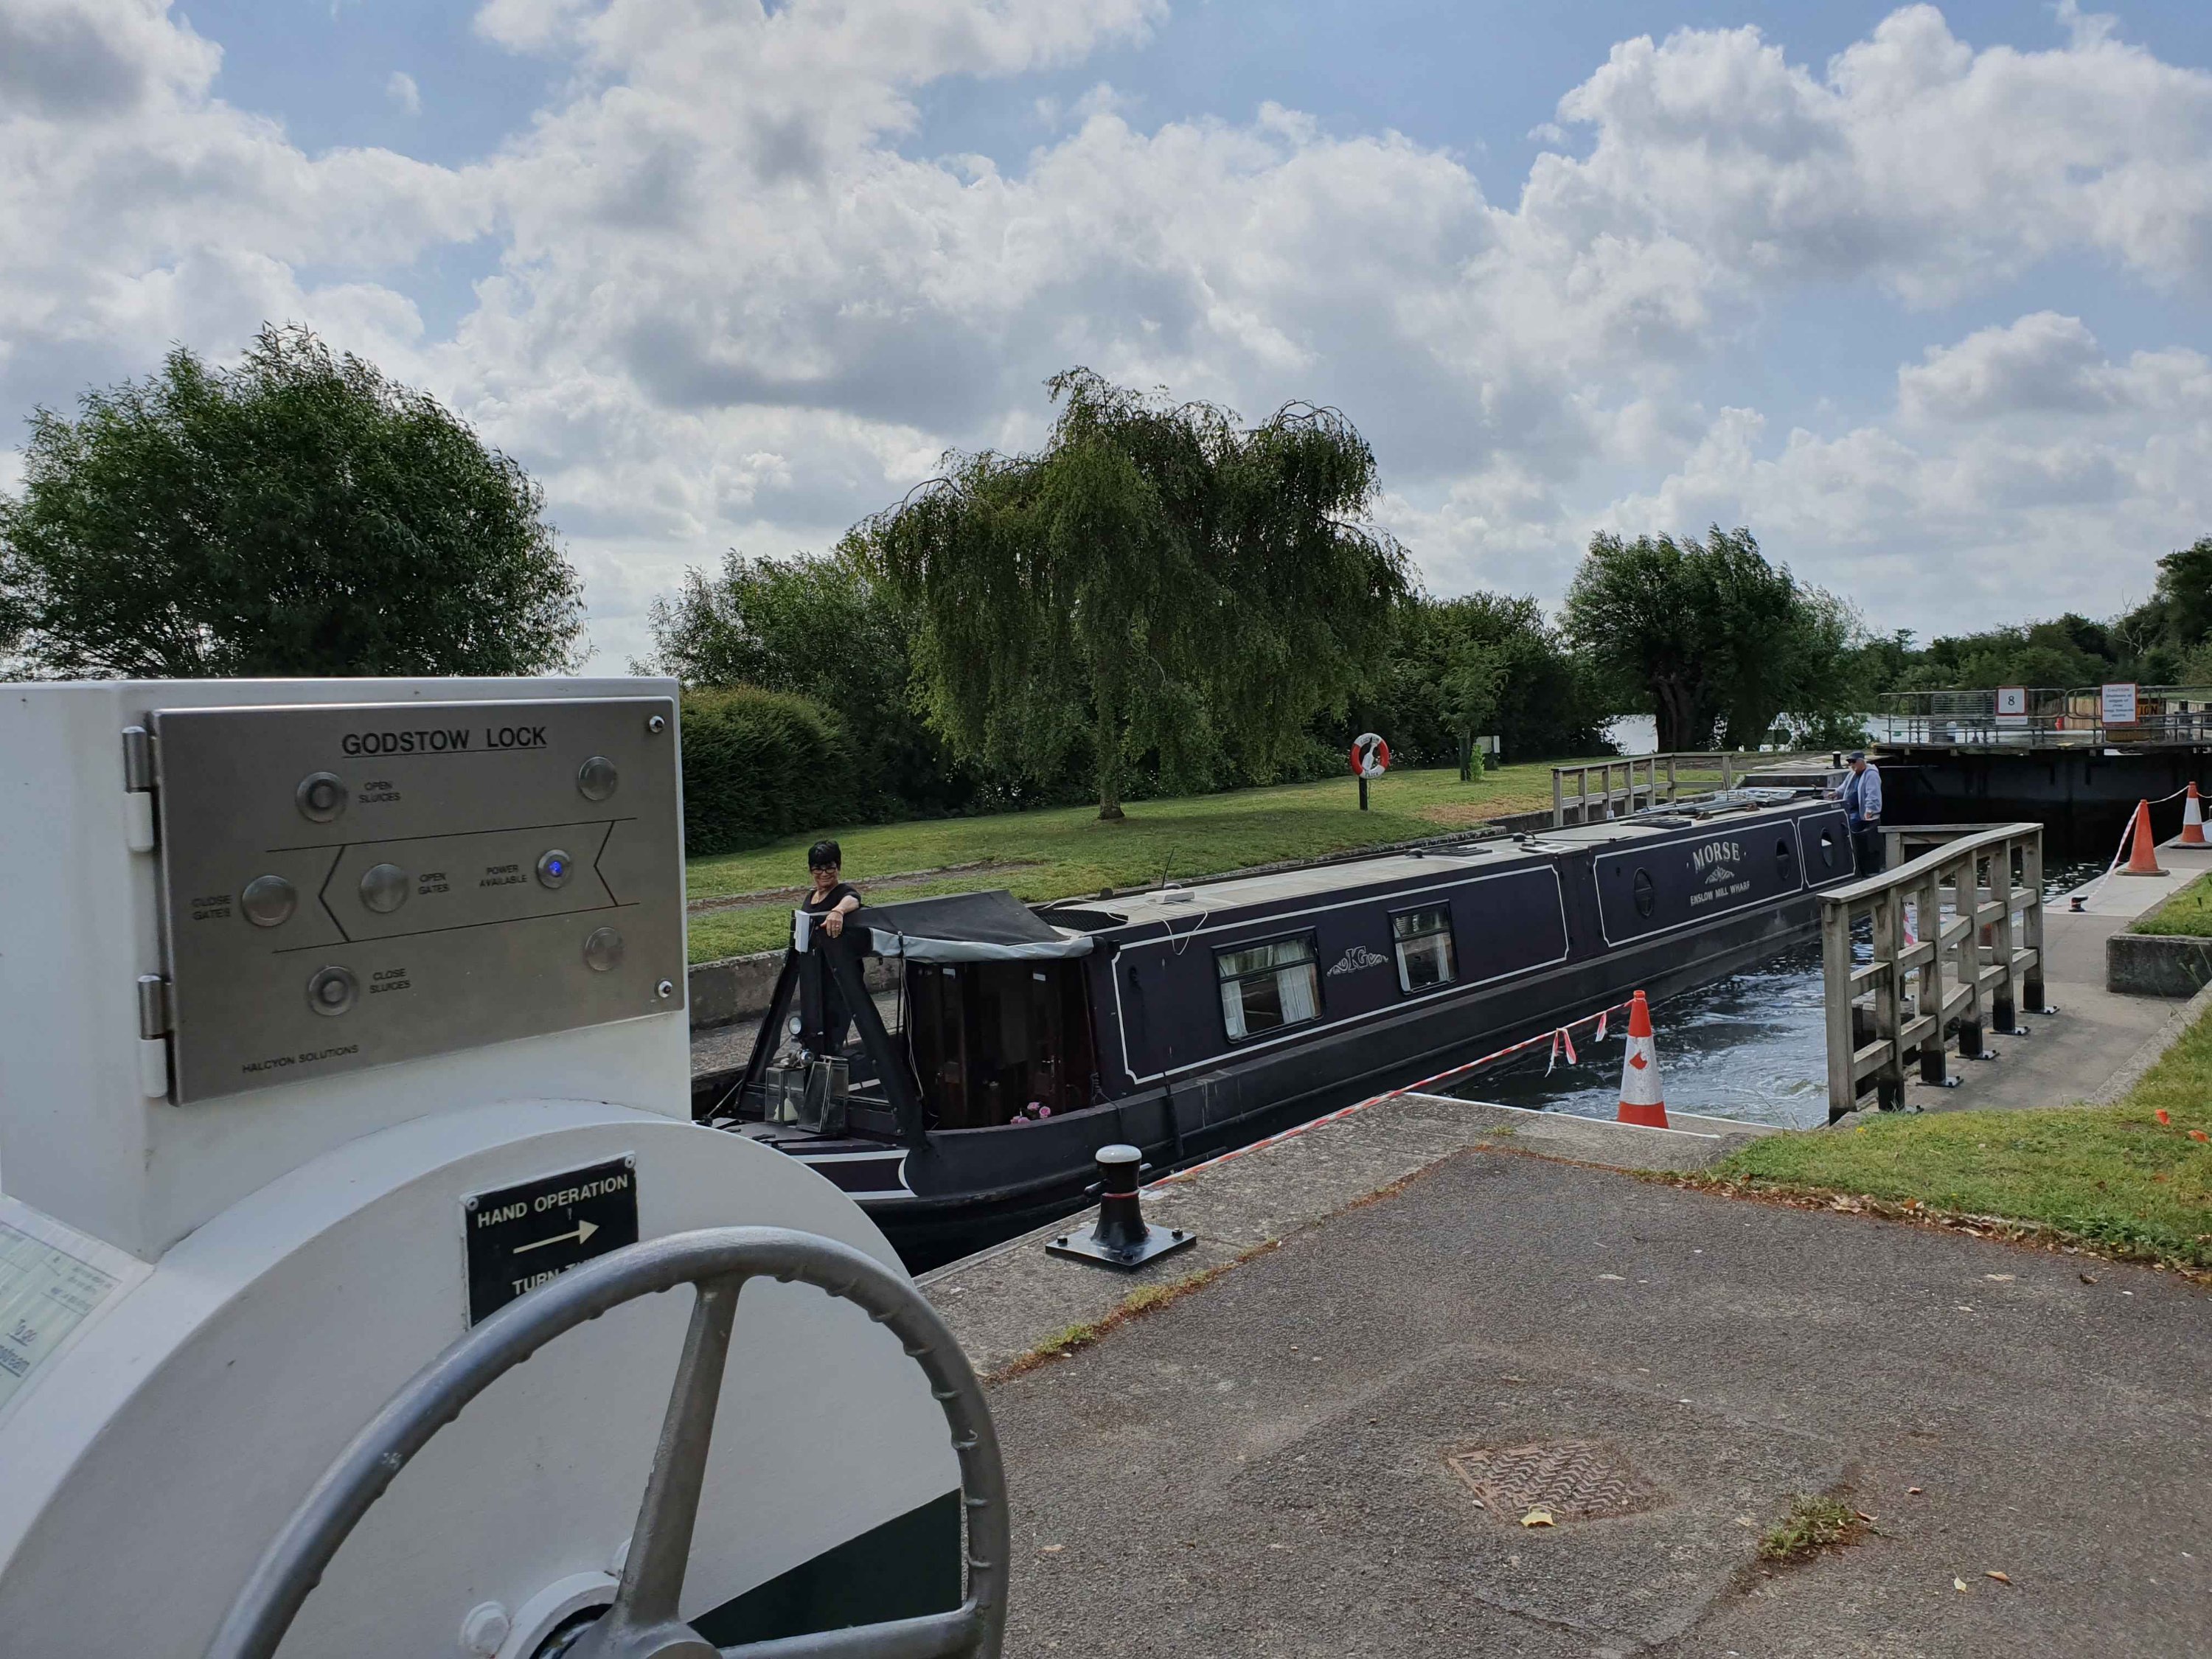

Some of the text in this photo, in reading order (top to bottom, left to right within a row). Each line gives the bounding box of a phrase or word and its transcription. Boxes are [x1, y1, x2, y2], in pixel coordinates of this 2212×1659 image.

[2008, 695, 2015, 706] 8
[341, 726, 547, 756] GODSTOW LOCK
[364, 780, 393, 790] OPEN
[358, 791, 401, 804] SLUICES
[1692, 841, 1741, 874] MORSE
[486, 864, 519, 874] POWER
[418, 872, 447, 883] OPEN
[479, 874, 528, 887] AVAILABLE
[417, 883, 451, 894] GATES
[1690, 880, 1750, 907] ENSLOW MILL WHARF
[372, 968, 407, 981] CLOSE
[369, 980, 411, 994] SLUICES
[242, 1044, 360, 1074] HALCYON SOLUTIONS
[477, 1174, 628, 1229] HAND OPERATION
[512, 1268, 560, 1295] TURN
